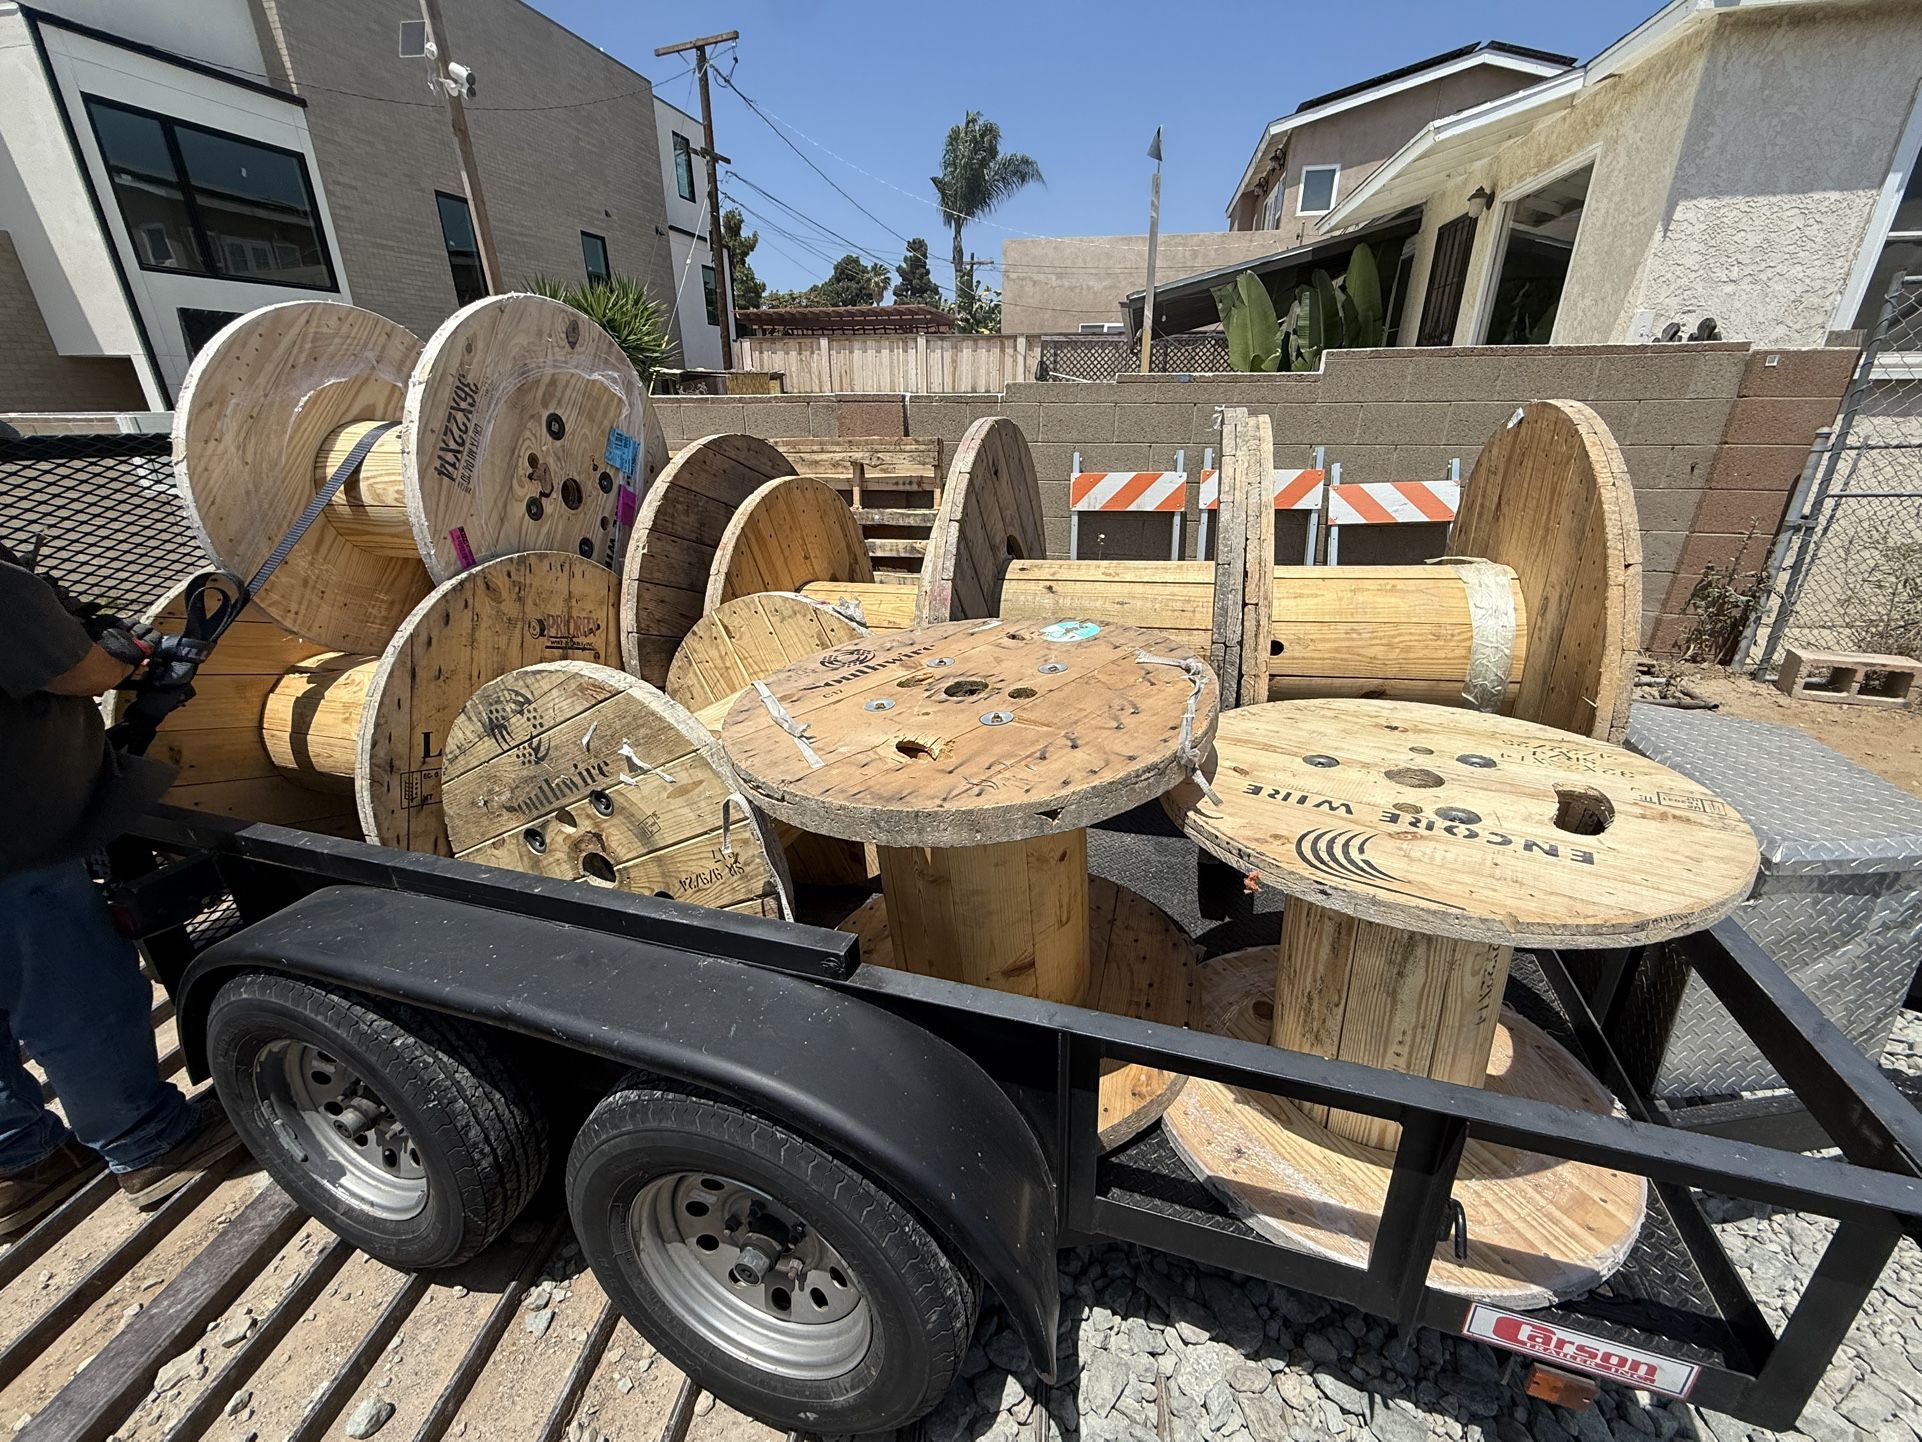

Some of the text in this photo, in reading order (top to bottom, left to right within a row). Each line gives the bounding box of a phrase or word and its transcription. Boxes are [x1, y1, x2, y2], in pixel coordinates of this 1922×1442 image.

[434, 373, 480, 482] 36X22X14
[546, 613, 600, 640] PRIORITY
[1242, 783, 1595, 866] ENCORE WIRE
[1492, 1316, 1658, 1378] Carson
